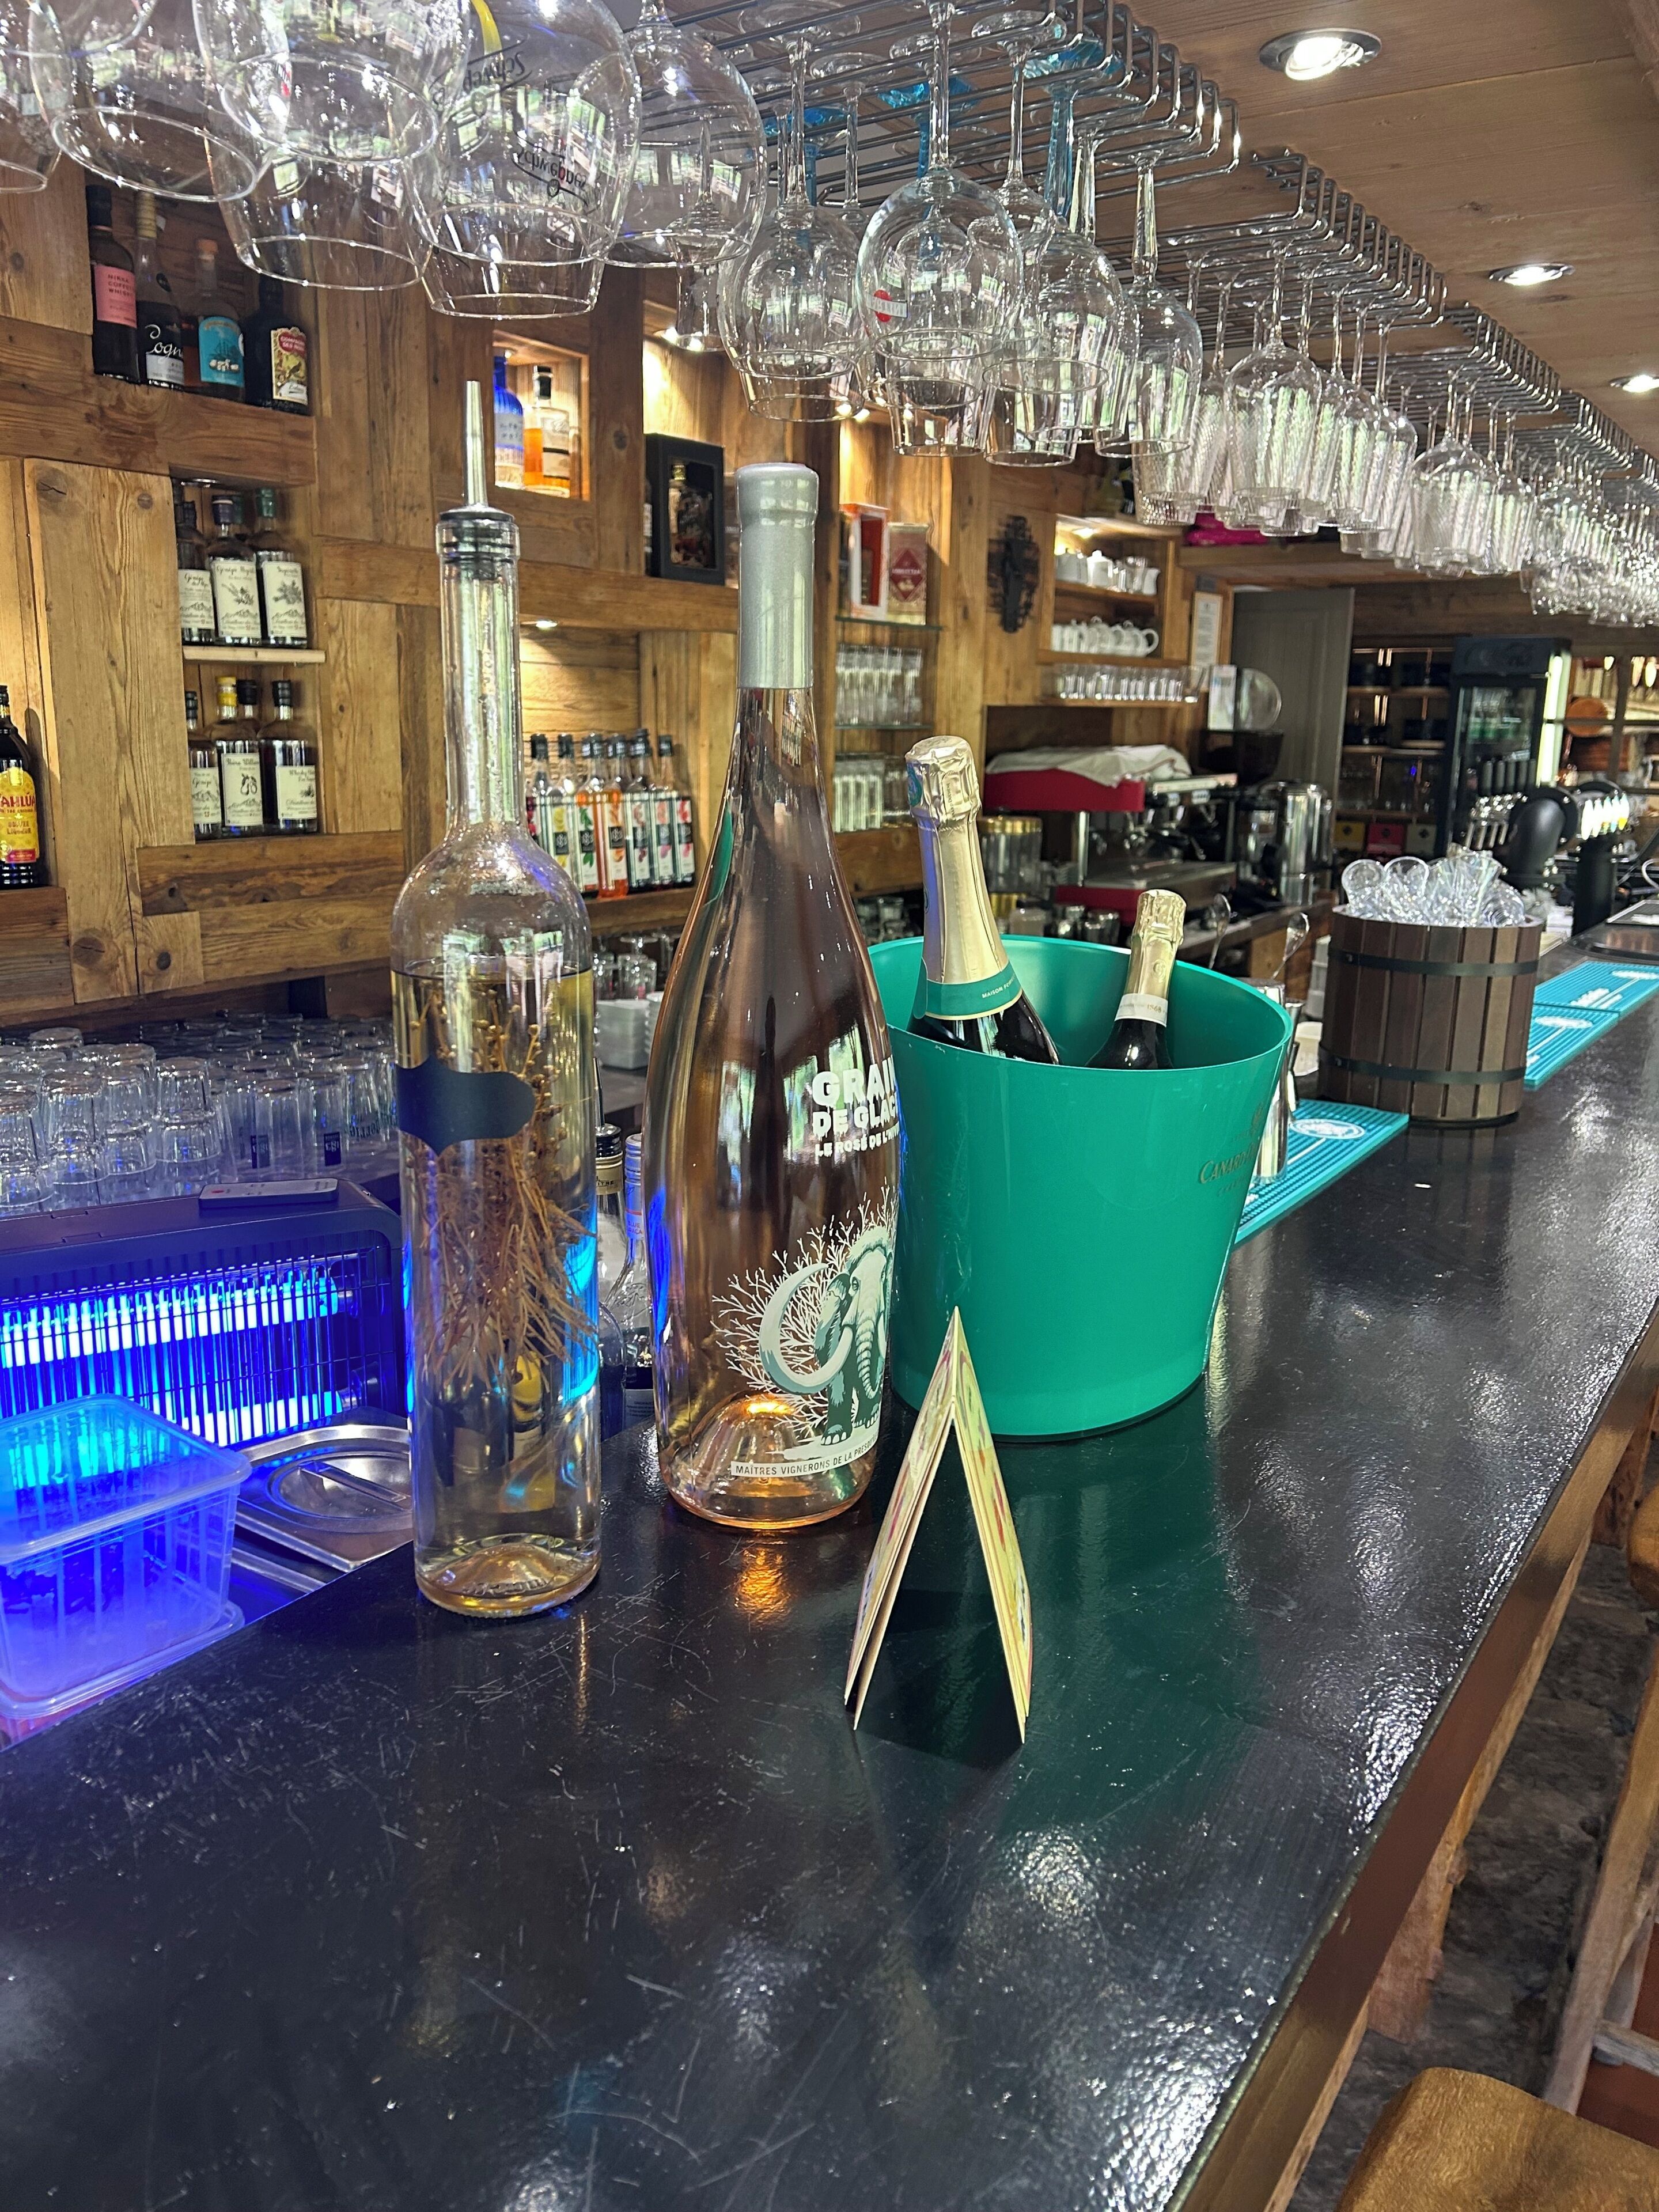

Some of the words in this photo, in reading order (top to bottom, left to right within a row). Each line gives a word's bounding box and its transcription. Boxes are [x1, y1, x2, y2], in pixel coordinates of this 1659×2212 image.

[0, 791, 35, 807] AHLÚA
[982, 986, 1003, 999] MAISON
[813, 1109, 848, 1142] DE
[815, 1143, 833, 1157] LE
[835, 1134, 868, 1153] ROSÉ
[869, 1132, 882, 1150] DE
[736, 1465, 777, 1475] MAÎTRES
[781, 1459, 831, 1475] VIGNERONS
[833, 1456, 842, 1465] DE
[844, 1450, 852, 1460] LA
